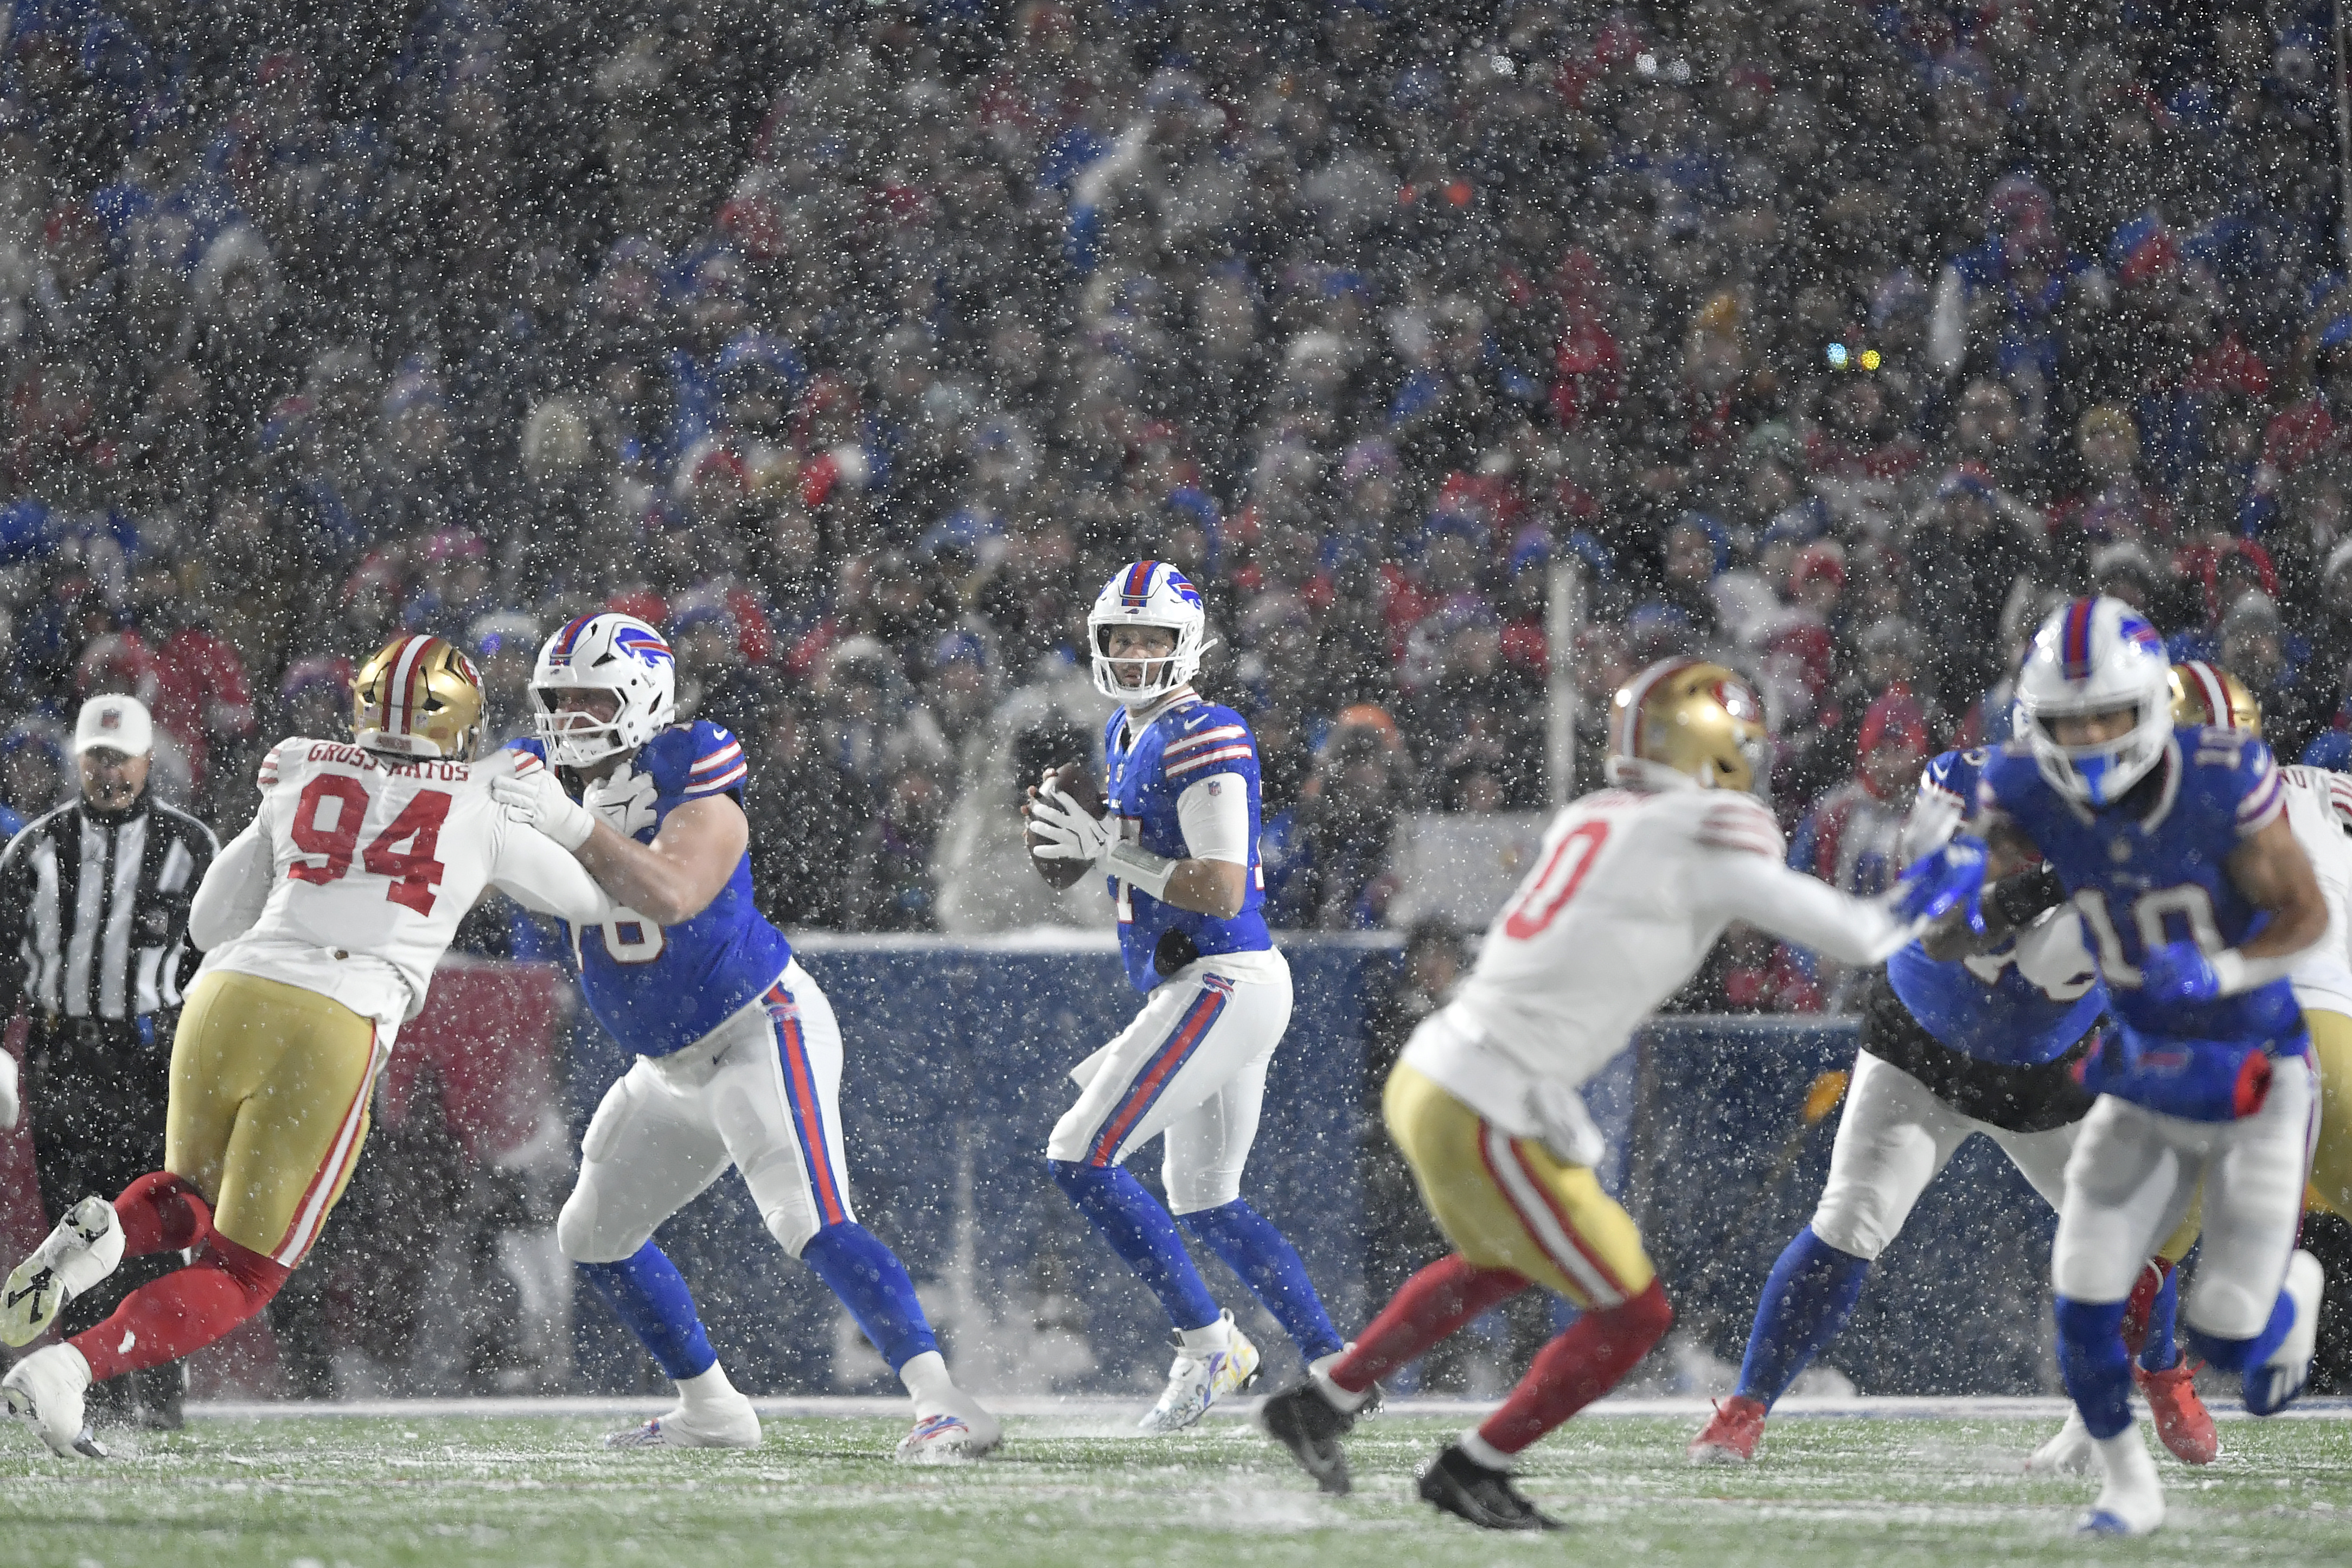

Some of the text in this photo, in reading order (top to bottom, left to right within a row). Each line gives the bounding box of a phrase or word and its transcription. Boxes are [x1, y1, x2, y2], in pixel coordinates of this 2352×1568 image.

[287, 773, 452, 918] 94
[1504, 819, 1610, 940] 0
[2073, 881, 2226, 989] 10
